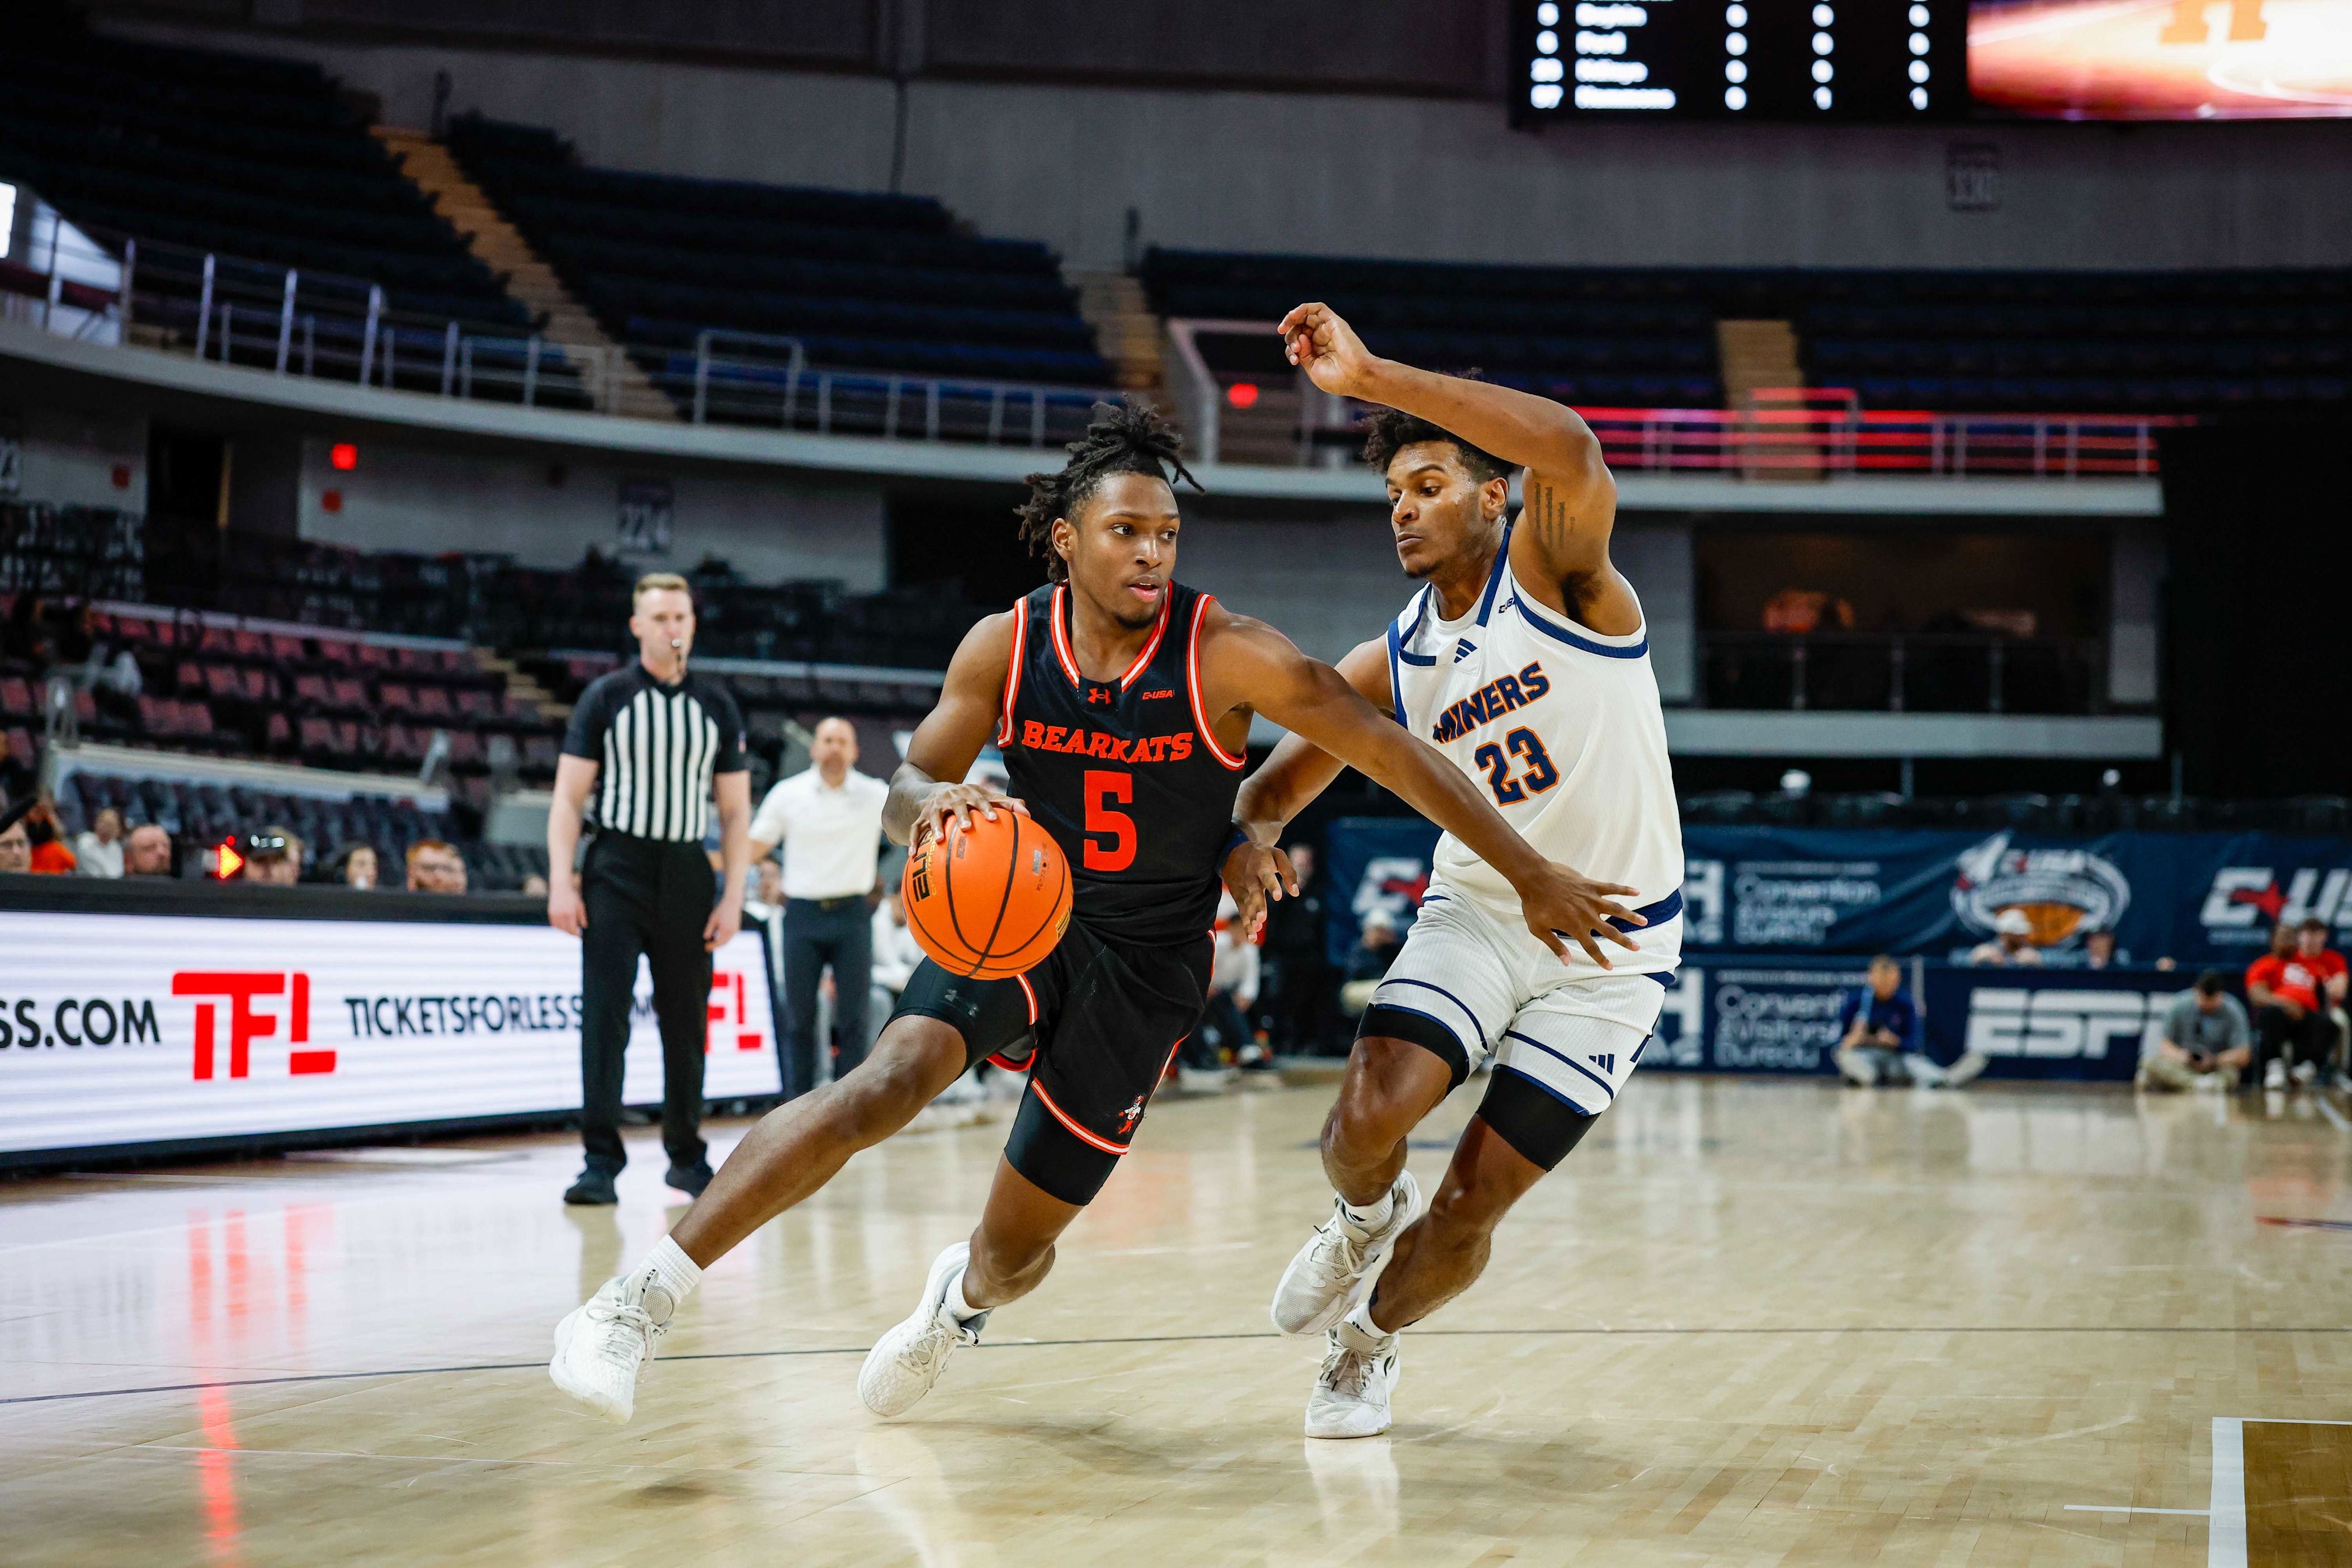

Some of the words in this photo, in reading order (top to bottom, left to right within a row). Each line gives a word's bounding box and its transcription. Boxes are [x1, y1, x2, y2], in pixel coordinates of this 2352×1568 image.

[1022, 720, 1193, 763] BEARKATS
[1433, 660, 1550, 744] MINERS
[1475, 726, 1560, 807] 23
[1084, 770, 1137, 871] 5
[172, 971, 337, 1081] TFL
[346, 993, 653, 1037] TICKETSFORLESS
[705, 973, 762, 1054] FL
